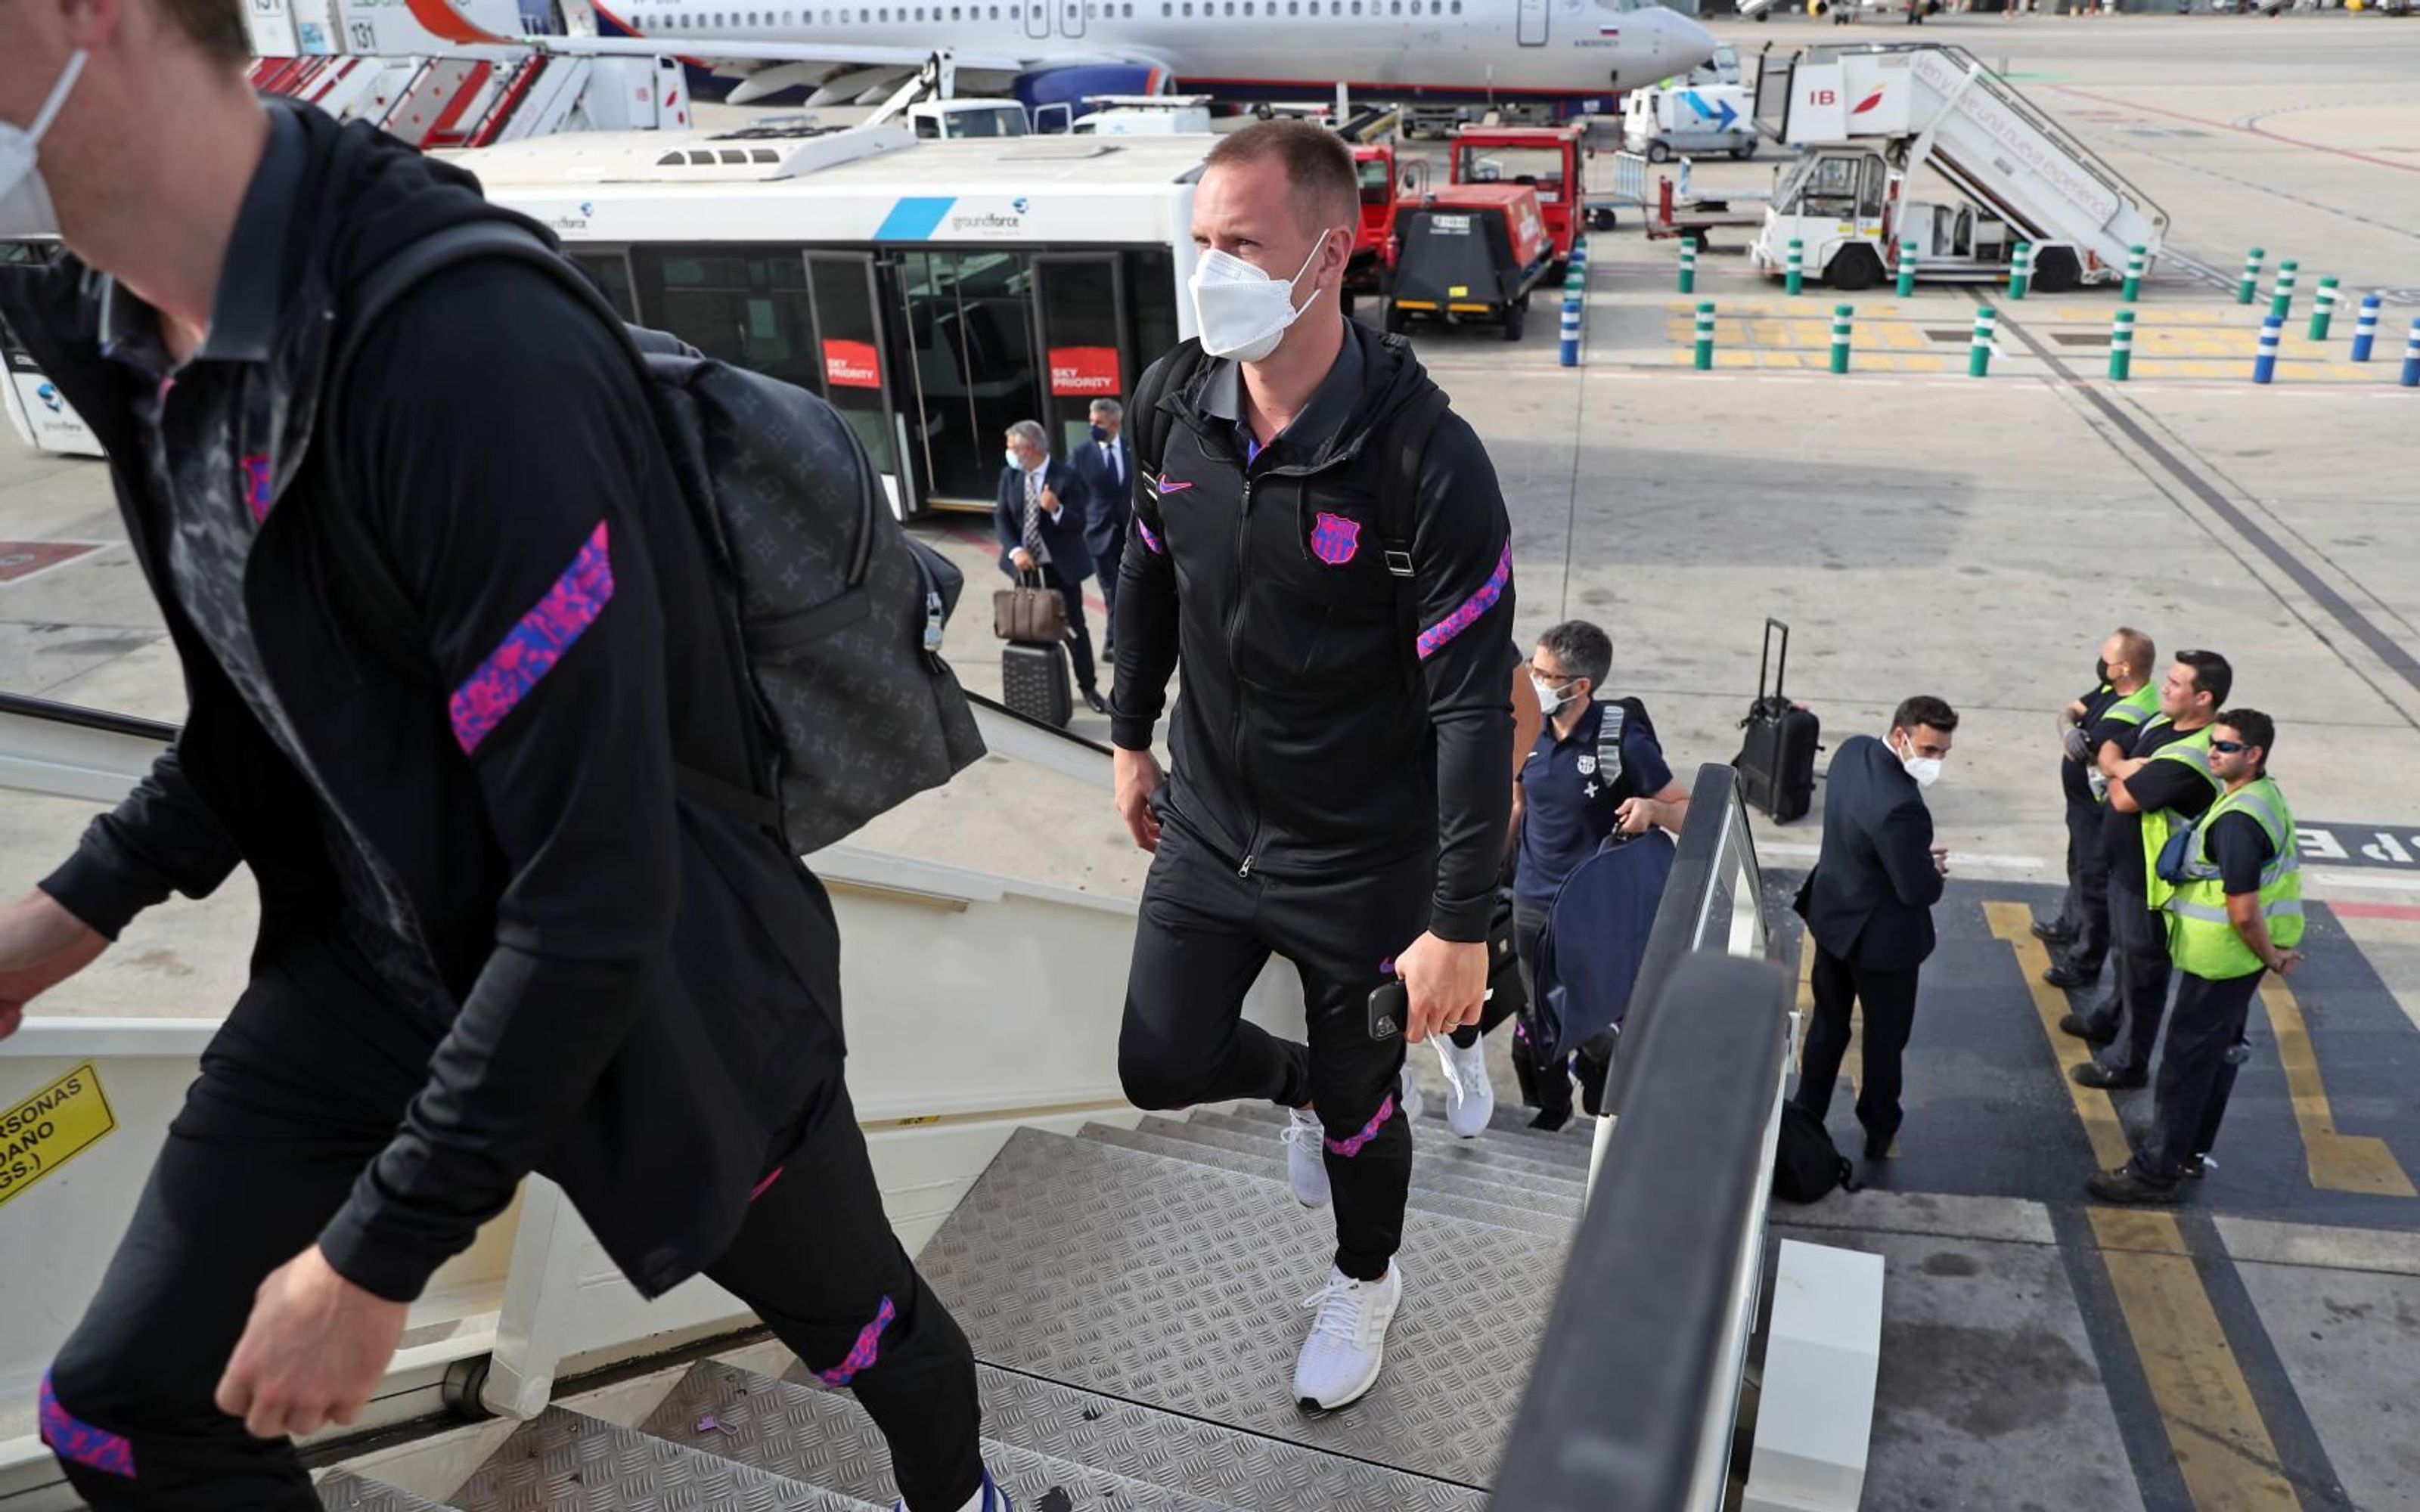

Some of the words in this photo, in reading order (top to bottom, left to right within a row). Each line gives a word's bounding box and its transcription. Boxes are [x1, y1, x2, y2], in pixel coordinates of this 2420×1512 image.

[351, 23, 377, 49] 131
[1810, 90, 1835, 106] IB
[828, 368, 874, 380] PRIORITY
[1053, 367, 1078, 378] SKY
[1053, 376, 1112, 389] PRIORITY
